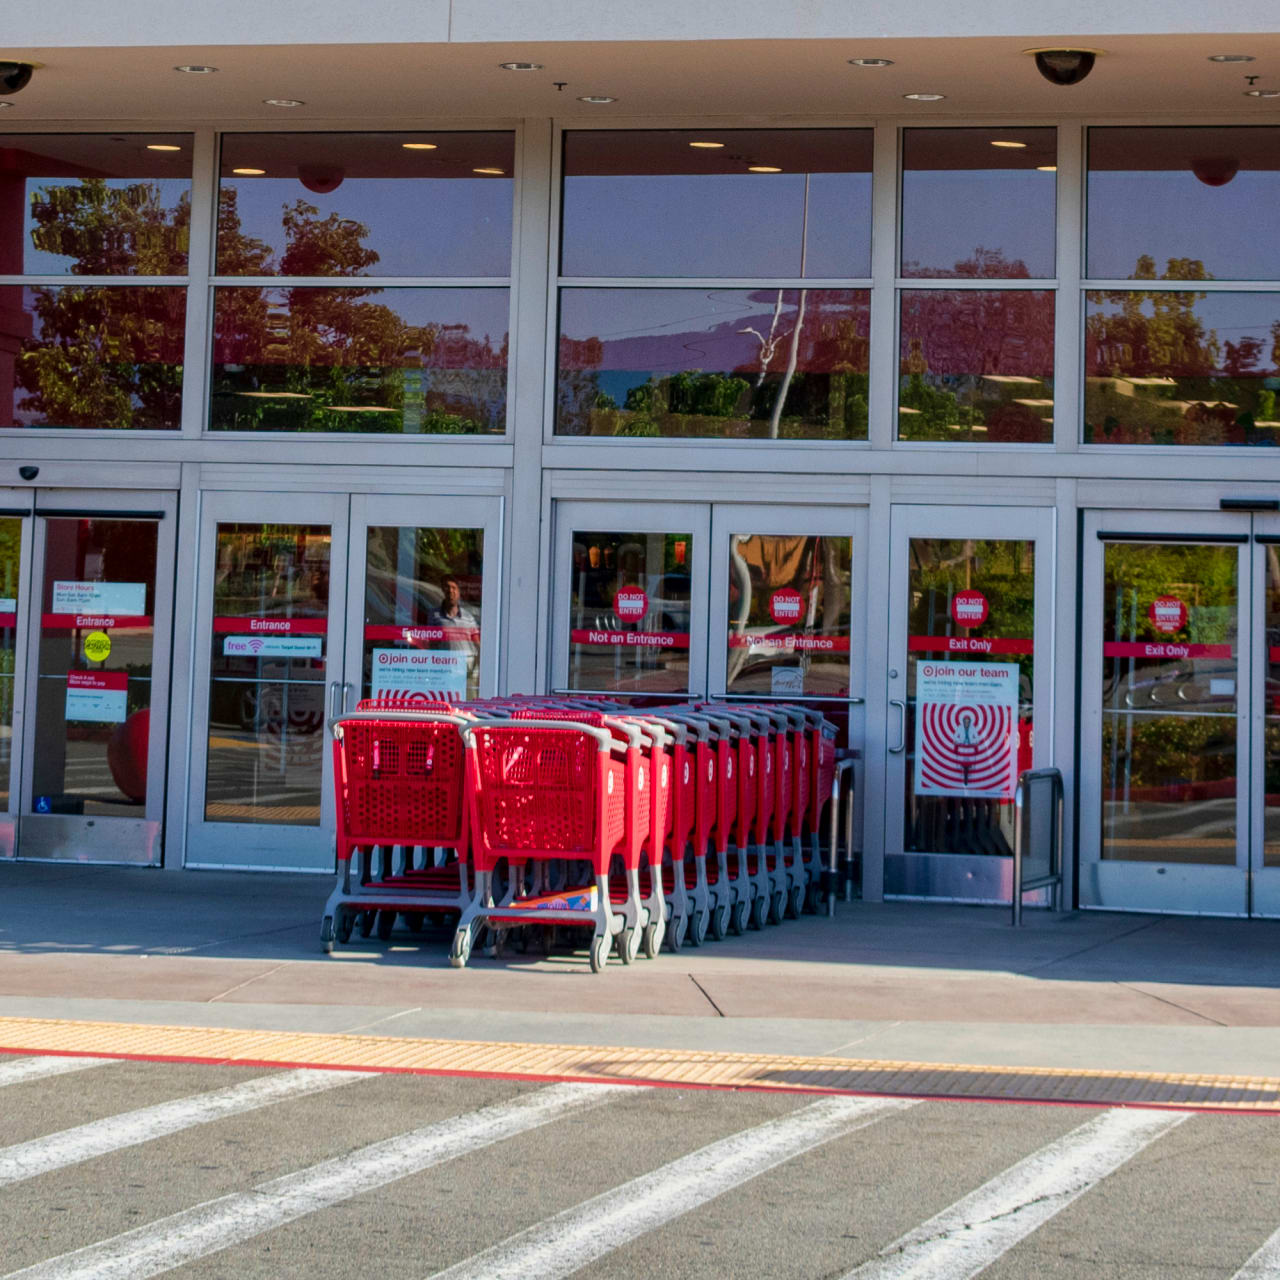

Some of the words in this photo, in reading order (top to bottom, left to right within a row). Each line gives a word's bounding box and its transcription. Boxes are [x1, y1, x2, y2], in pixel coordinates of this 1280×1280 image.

[76, 616, 115, 627] Entrance
[250, 619, 291, 630] Entrance
[402, 627, 443, 638] Entrance
[589, 632, 608, 642] Not
[611, 635, 624, 643] an
[627, 633, 674, 645] Entrance
[227, 641, 247, 650] free
[746, 636, 766, 646] Not
[768, 639, 782, 647] an
[785, 637, 833, 648] Entrance
[949, 638, 967, 649] Exit
[970, 639, 992, 652] Only
[1145, 645, 1164, 655] Exit
[1166, 646, 1189, 657] Only
[389, 653, 408, 665] join
[411, 656, 428, 664] our
[431, 655, 458, 665] team
[935, 665, 955, 677] join
[958, 668, 977, 677] our
[980, 667, 1009, 678] team
